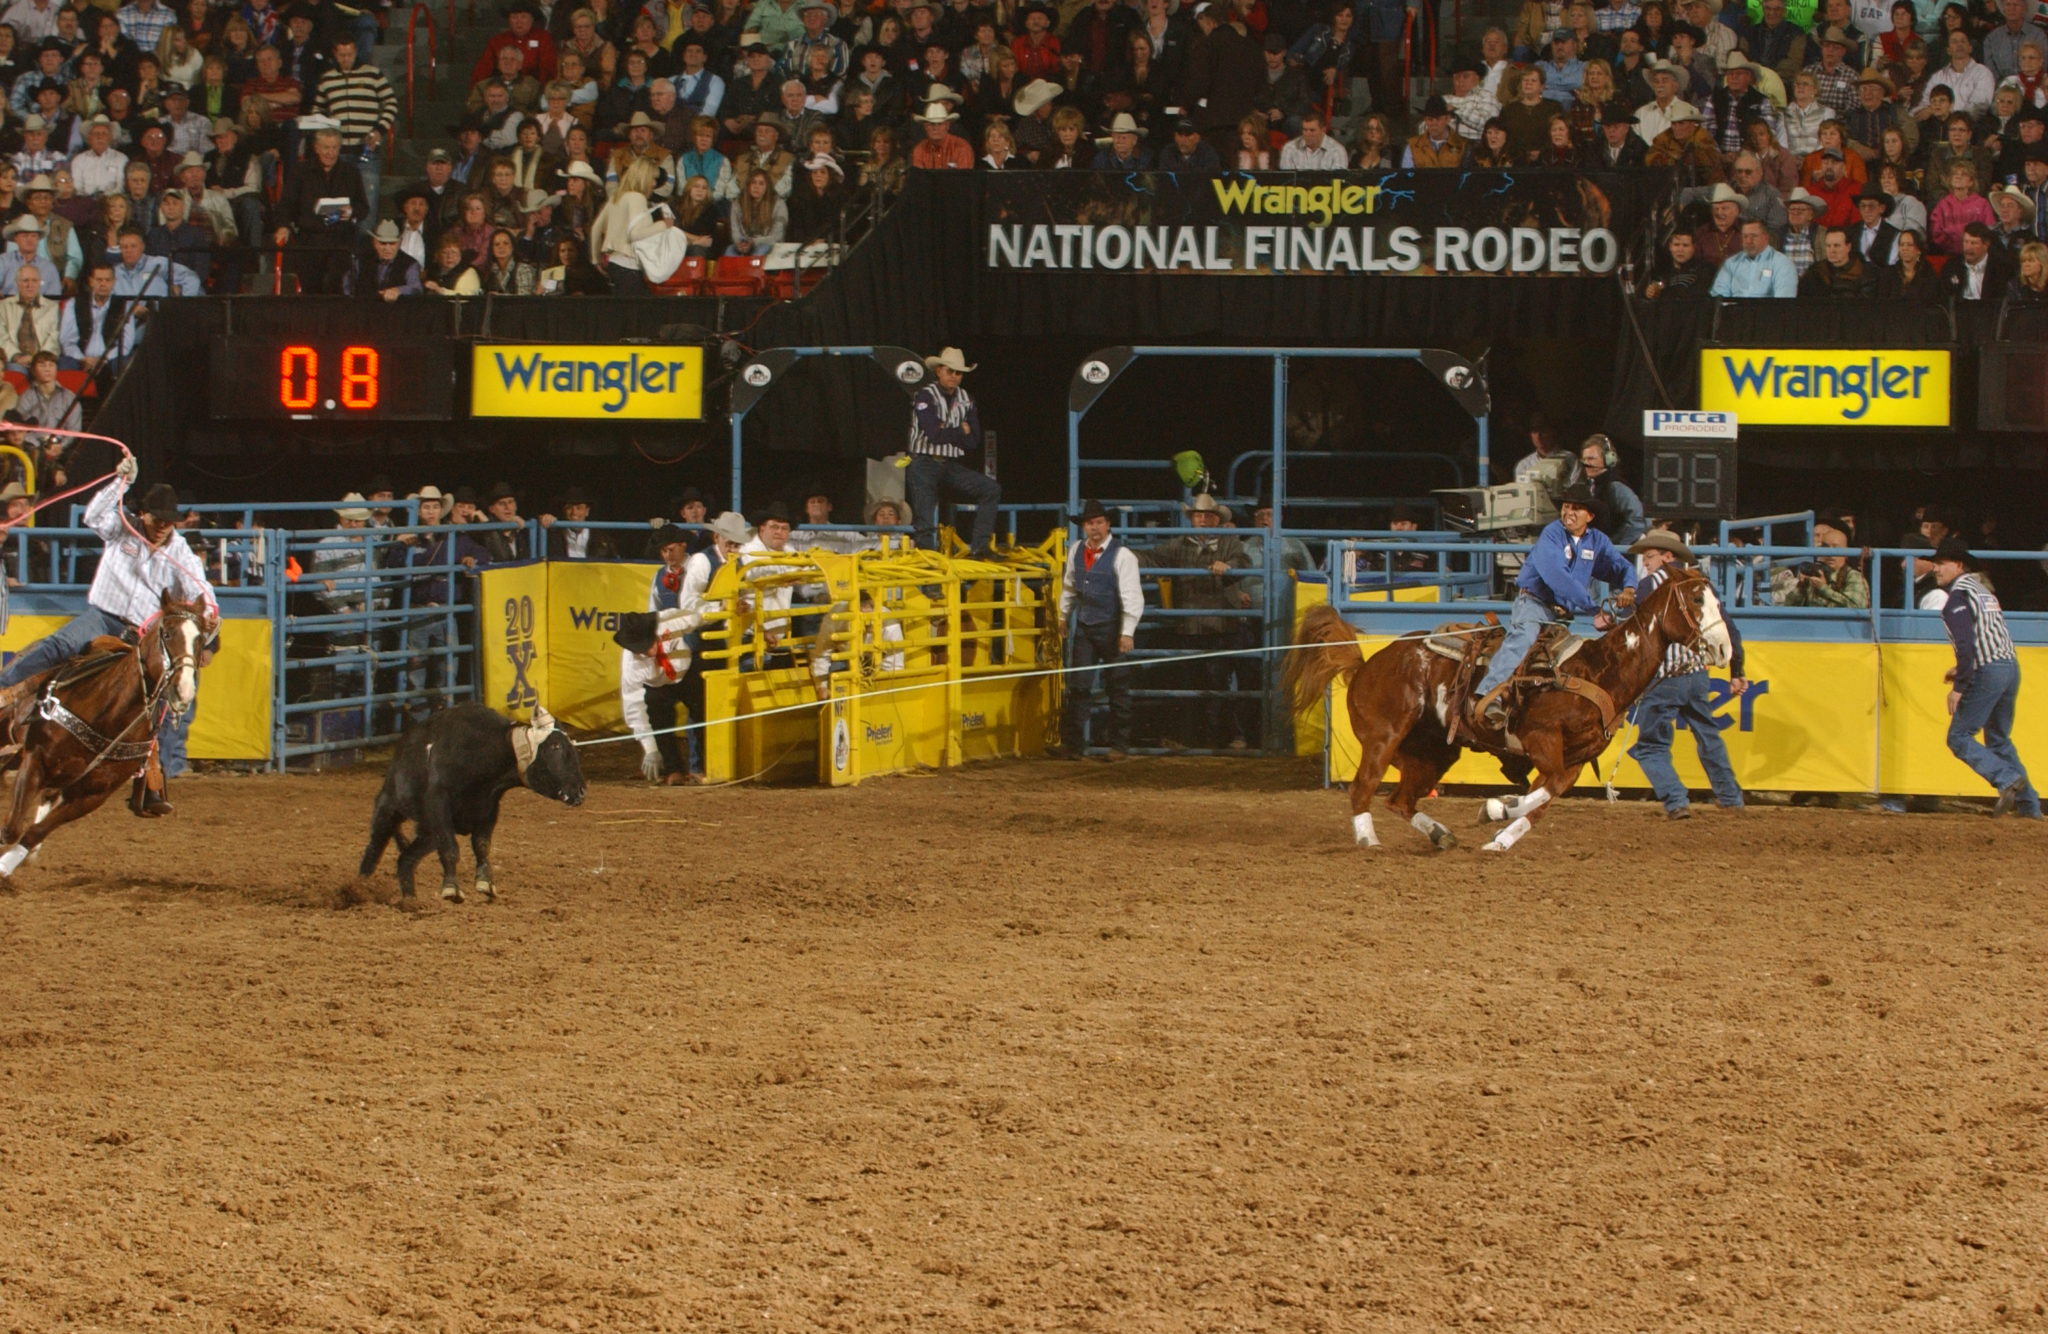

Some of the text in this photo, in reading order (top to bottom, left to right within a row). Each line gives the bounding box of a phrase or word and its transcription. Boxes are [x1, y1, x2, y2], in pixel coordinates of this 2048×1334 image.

[1860, 8, 1883, 20] GAP
[1212, 178, 1381, 229] Wrangler
[988, 223, 1618, 273] NATIONAL FINALS RODEO
[280, 345, 379, 410] 0.8
[494, 352, 685, 413] Wrangler
[1722, 356, 1930, 420] Wrangler
[1652, 412, 1726, 431] prca
